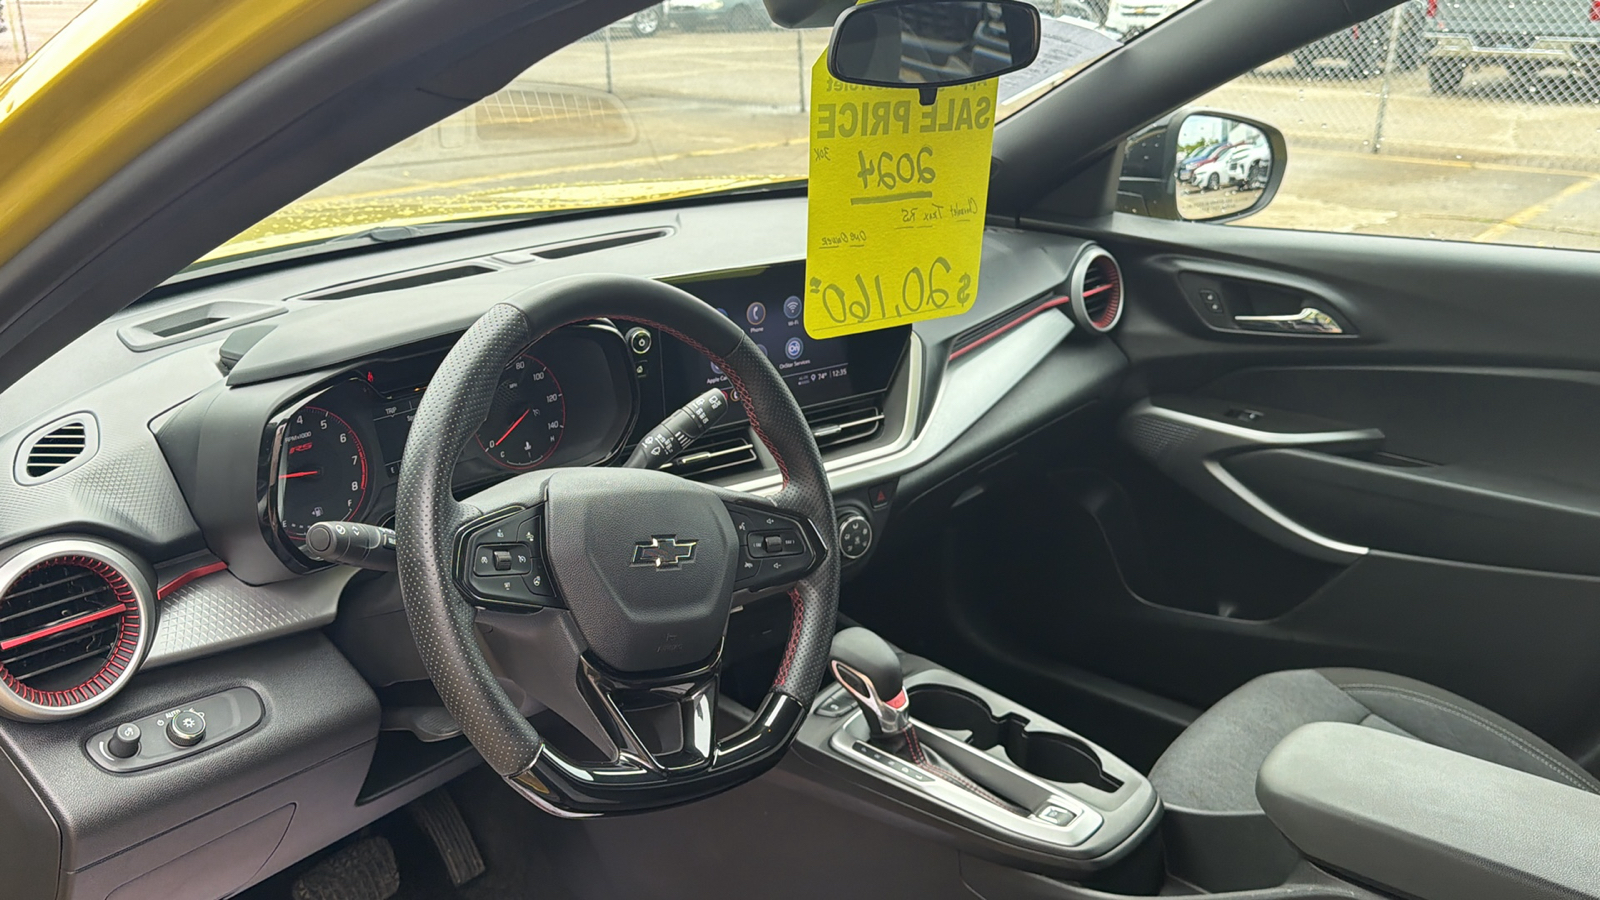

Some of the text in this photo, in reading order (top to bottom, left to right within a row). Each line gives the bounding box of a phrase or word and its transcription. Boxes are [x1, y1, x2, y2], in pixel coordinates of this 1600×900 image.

[320, 419, 328, 430] 5
[339, 433, 347, 443] 6
[351, 455, 358, 466] 7
[351, 481, 358, 491] 8
